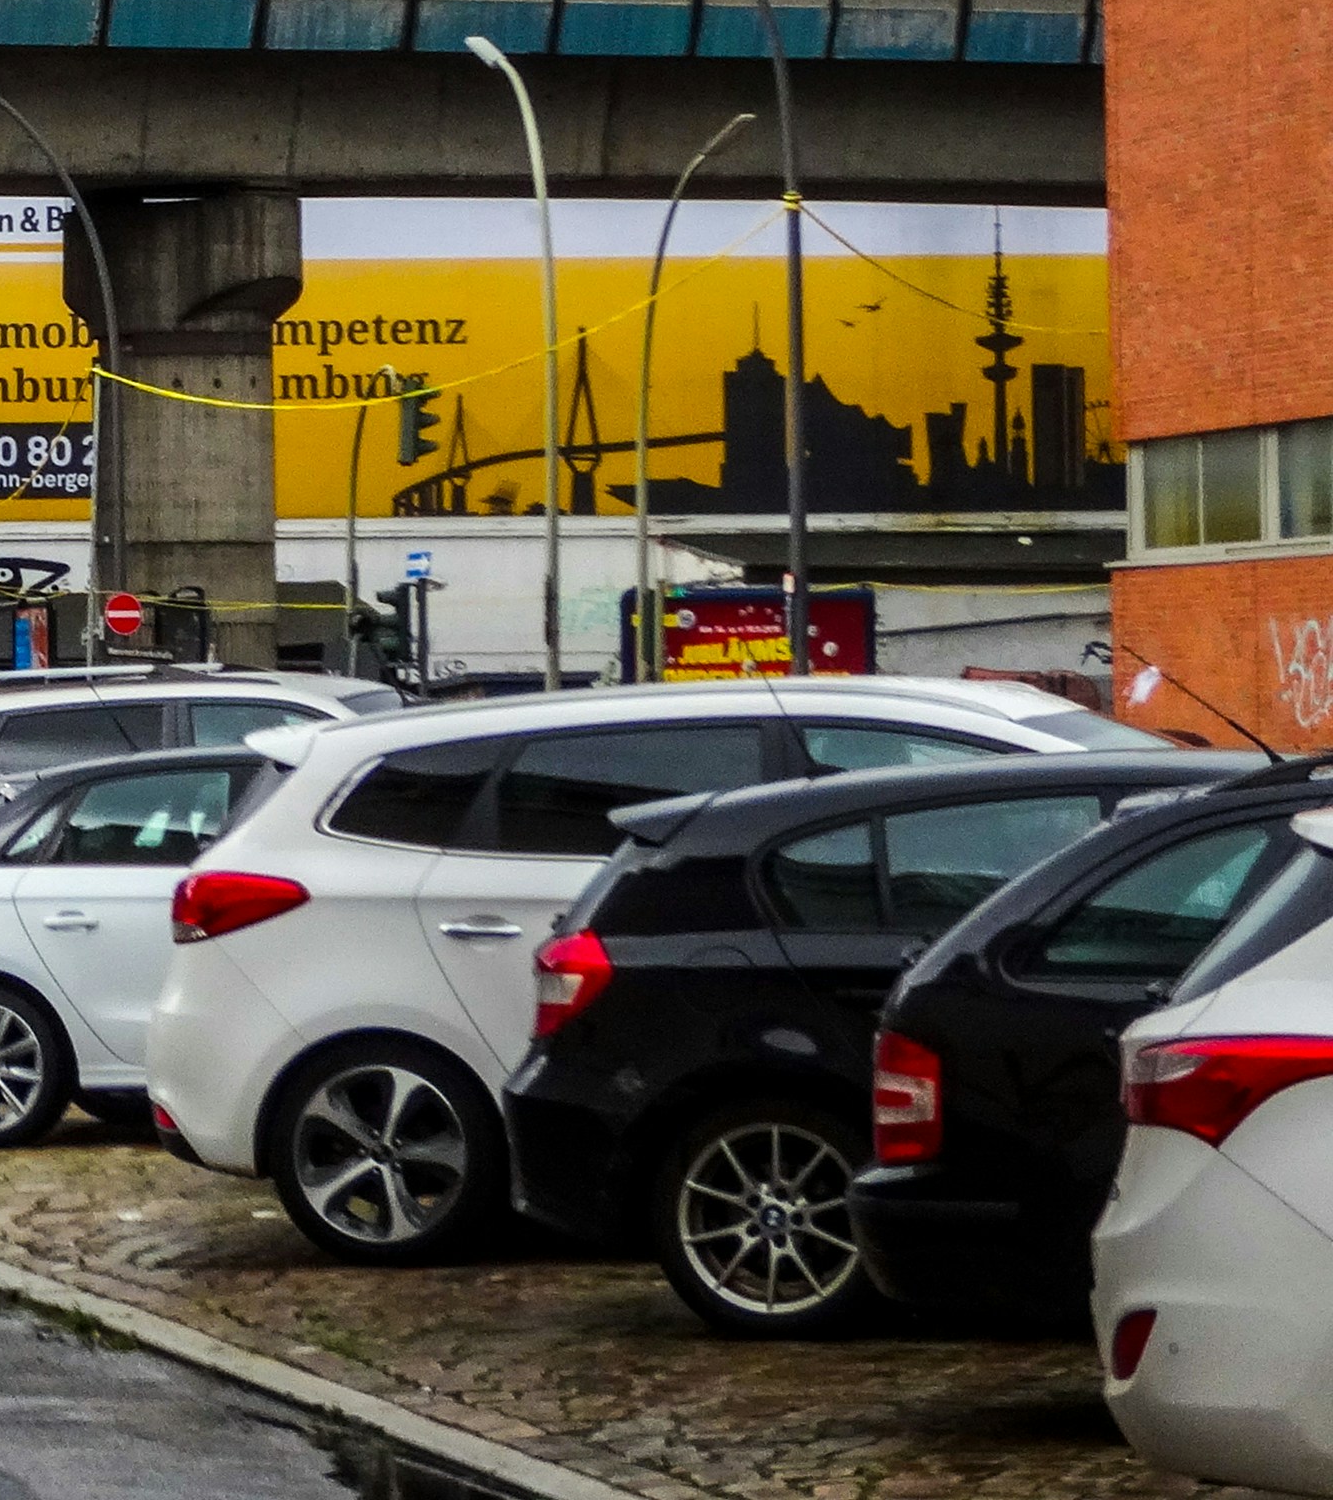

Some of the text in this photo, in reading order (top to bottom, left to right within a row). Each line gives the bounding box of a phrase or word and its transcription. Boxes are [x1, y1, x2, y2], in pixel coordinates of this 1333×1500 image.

[20, 207, 39, 233] &
[273, 314, 468, 356] mpetenz
[27, 435, 72, 467] 80
